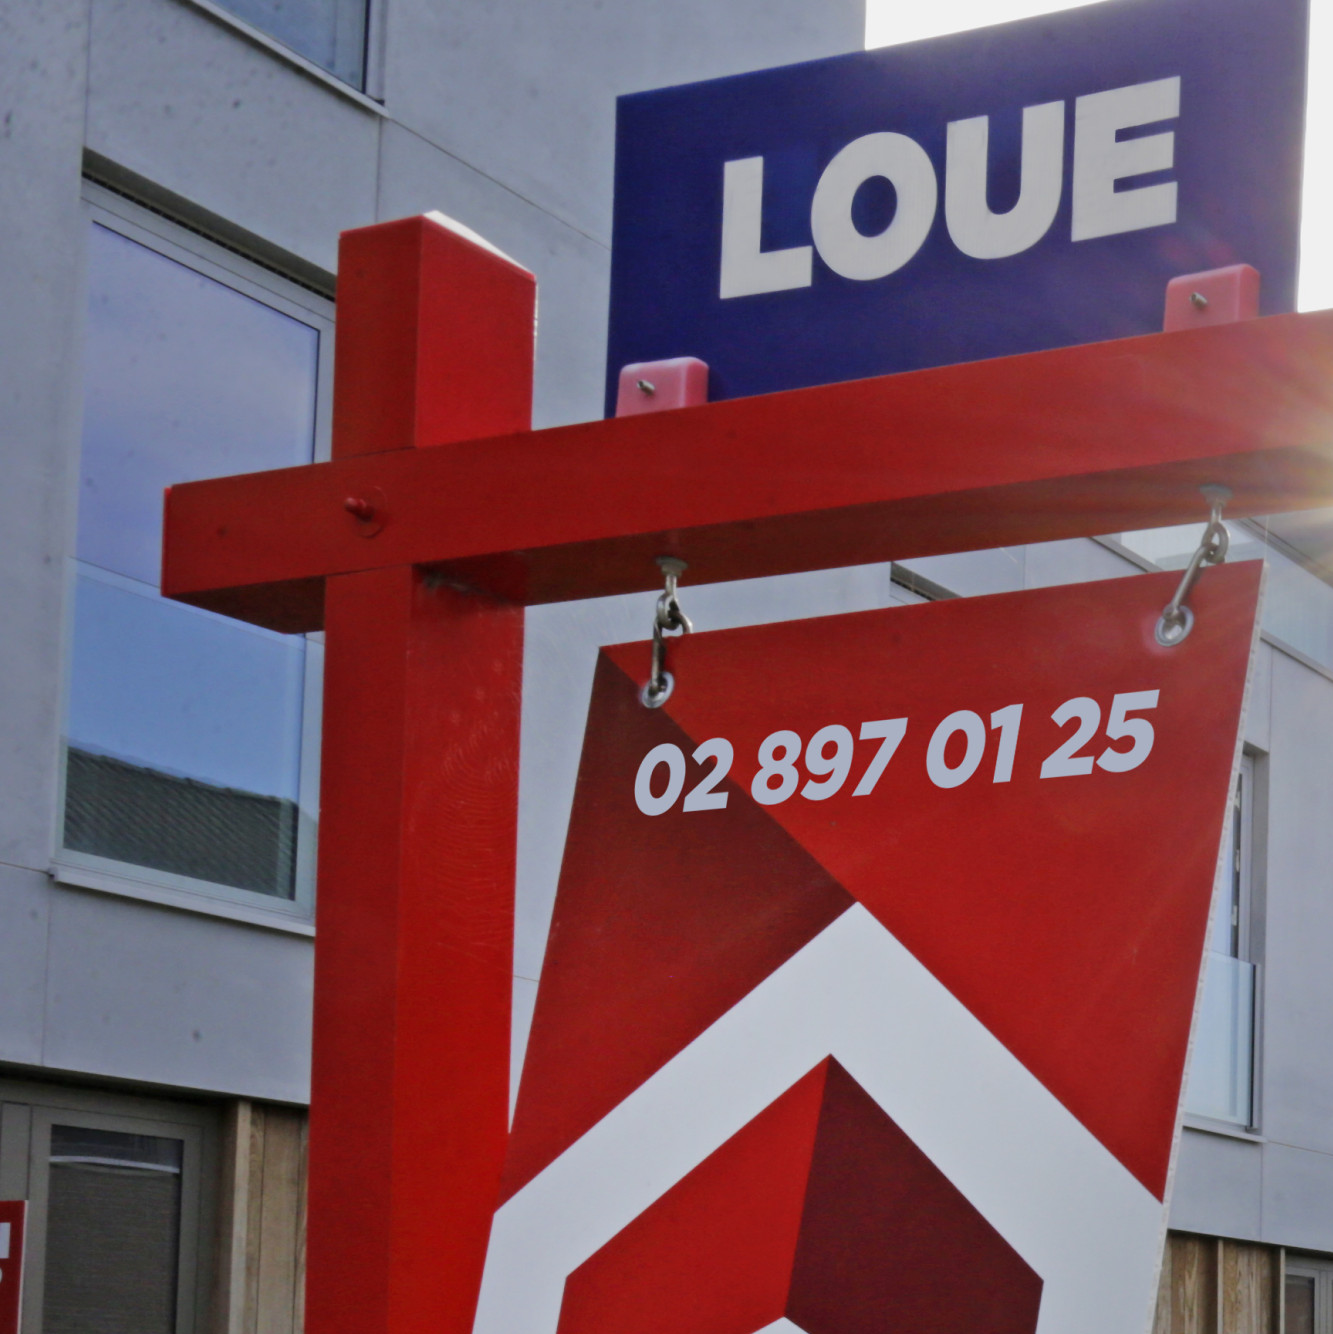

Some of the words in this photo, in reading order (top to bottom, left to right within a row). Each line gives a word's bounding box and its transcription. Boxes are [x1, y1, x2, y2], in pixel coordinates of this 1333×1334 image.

[720, 76, 1181, 299] LOUE
[634, 737, 734, 816] 02
[750, 717, 908, 805] 897
[926, 703, 1024, 788] 01
[1039, 689, 1160, 779] 25
